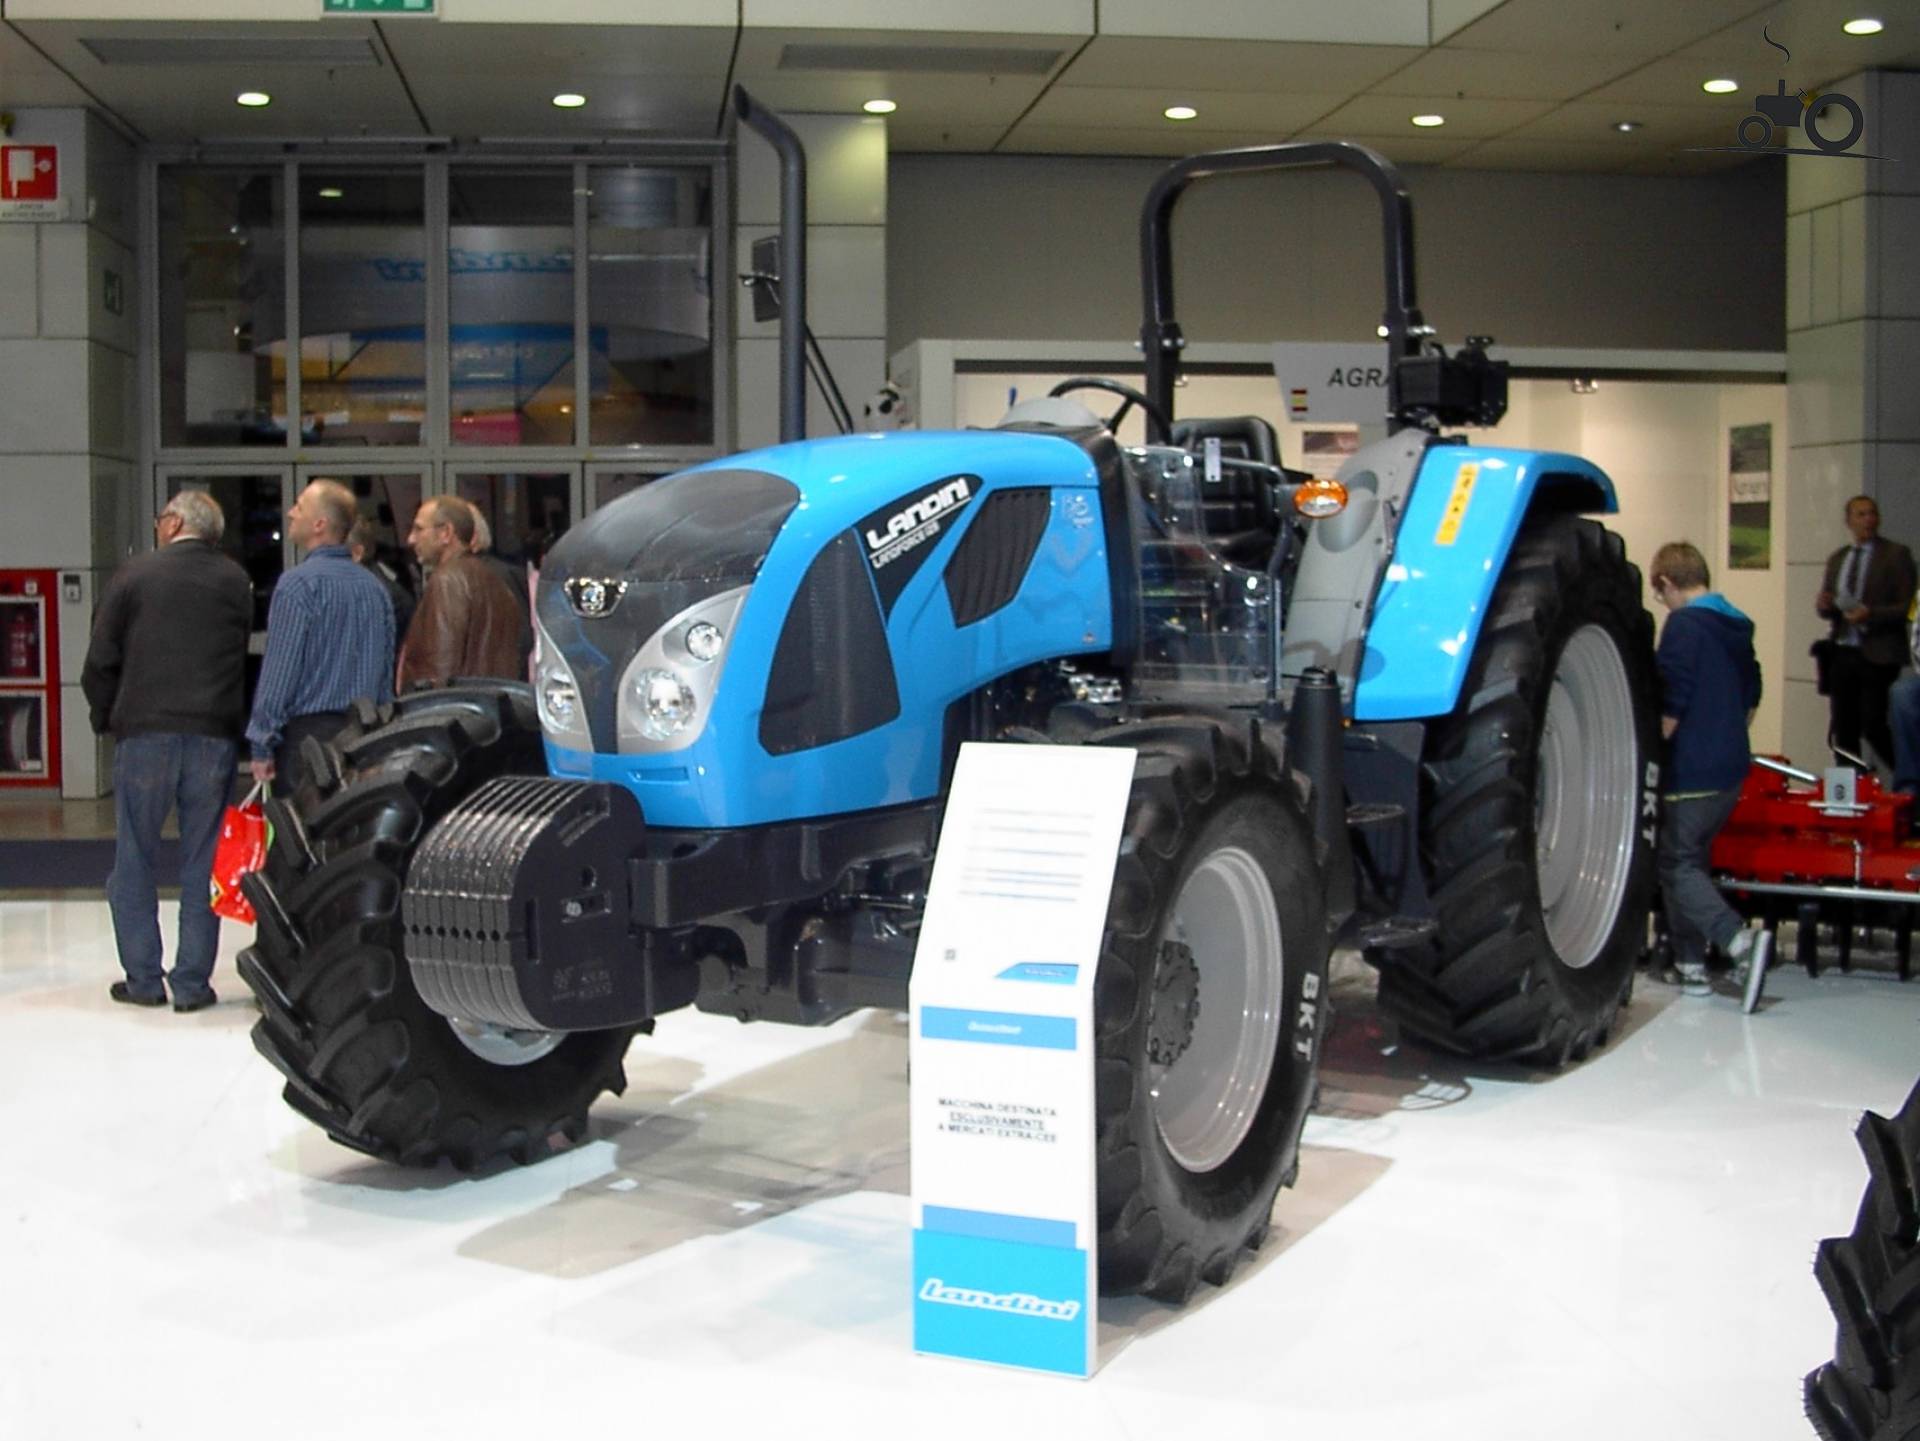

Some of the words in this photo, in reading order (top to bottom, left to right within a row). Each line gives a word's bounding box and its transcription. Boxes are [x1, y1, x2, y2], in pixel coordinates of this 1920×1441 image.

[866, 477, 969, 549] LANDINI
[1643, 761, 1660, 848] BKT
[1297, 972, 1320, 1061] BKT
[919, 1277, 1081, 1320] Landini
